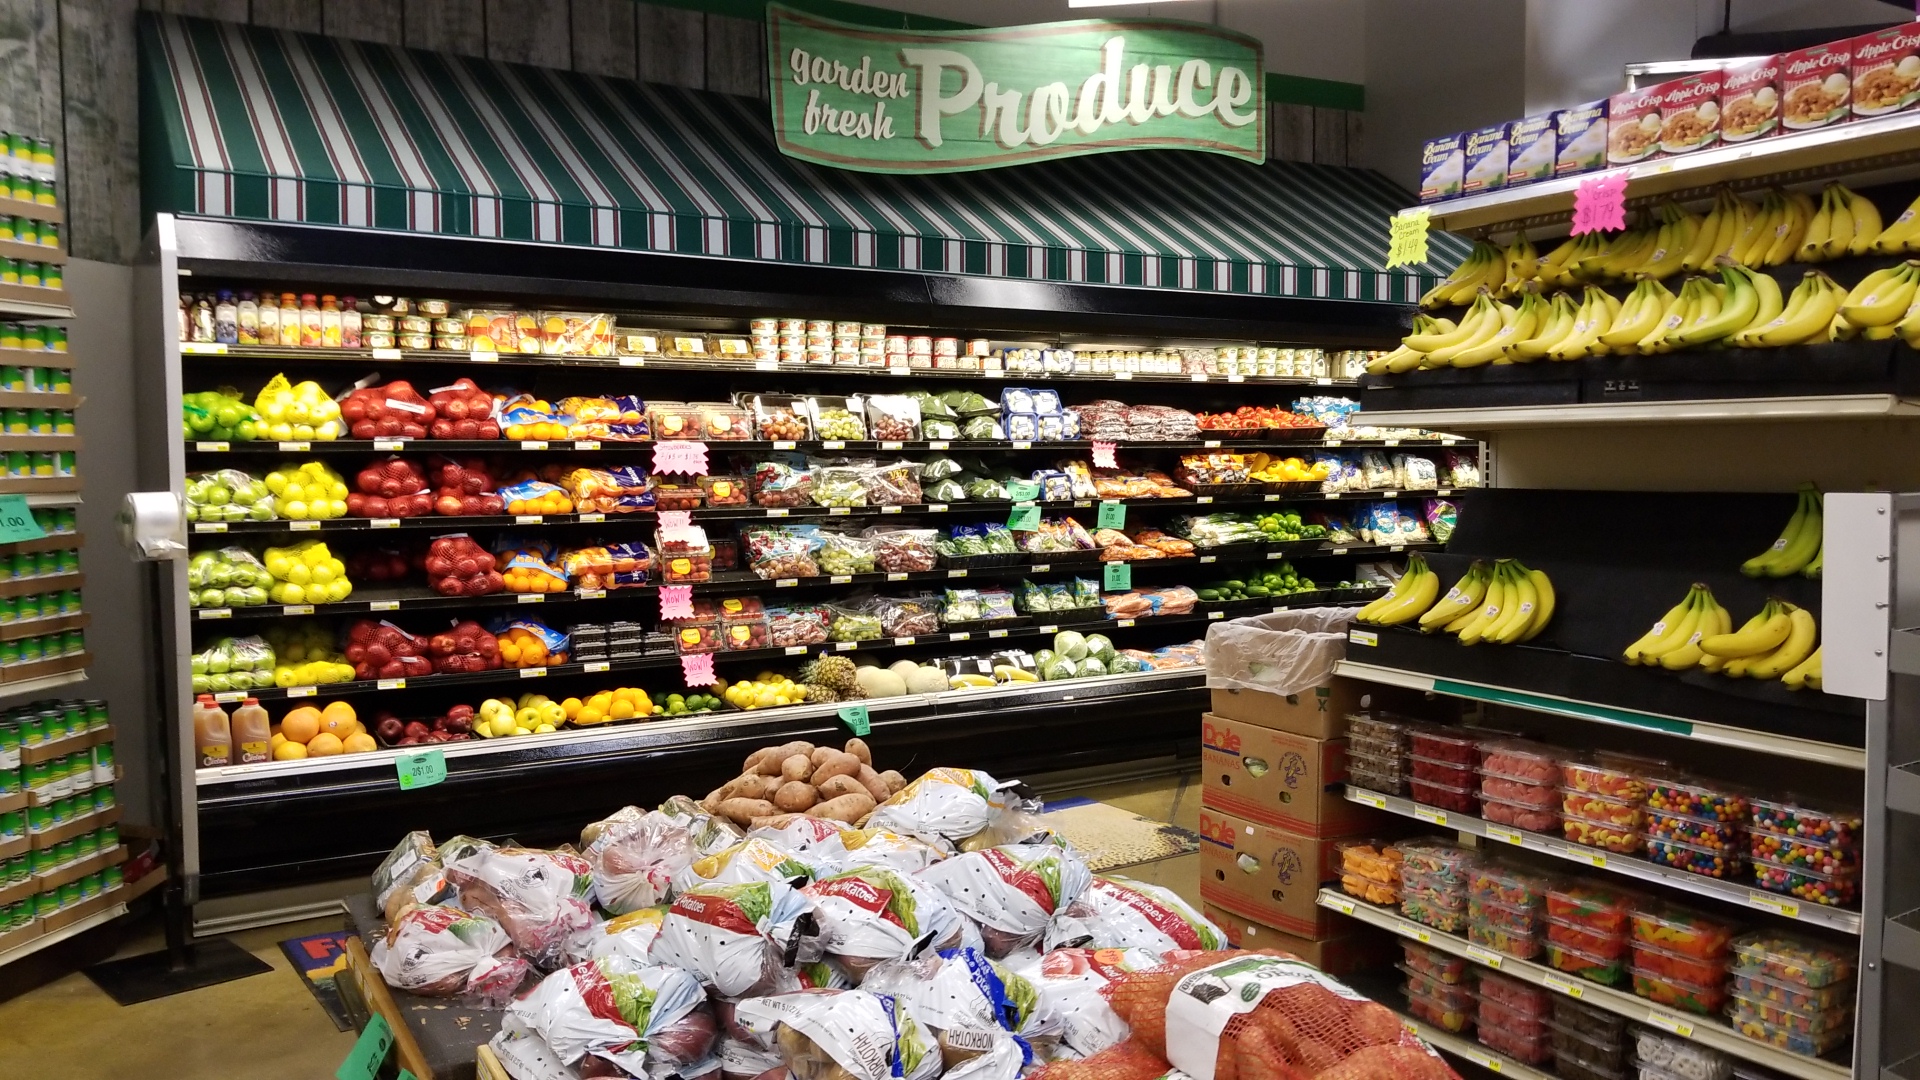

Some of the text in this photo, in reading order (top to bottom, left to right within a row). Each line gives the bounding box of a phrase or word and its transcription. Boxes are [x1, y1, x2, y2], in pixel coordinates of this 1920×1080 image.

[1855, 42, 1892, 59] Apple
[789, 46, 910, 98] garden
[1786, 52, 1851, 74] Apple Crisp
[1723, 67, 1778, 90] Apple Crisp
[901, 36, 1256, 149] Produce
[1665, 82, 1720, 103] Apple Crisp
[1611, 95, 1663, 115] Apple Crisp
[805, 89, 896, 141] fresh
[1559, 107, 1603, 124] Banana
[1510, 119, 1551, 135] Banana
[1558, 121, 1590, 136] Cream
[1467, 130, 1504, 145] Banana
[1510, 132, 1539, 146] Cream
[1424, 140, 1459, 154] Banana
[1466, 144, 1493, 157] Cream
[1423, 153, 1448, 165] Cream
[1394, 219, 1419, 234] Banana
[1203, 723, 1241, 751] Dole
[1203, 752, 1240, 770] BANANAS
[412, 765, 433, 776] 2/$1.00
[1200, 815, 1236, 846] Dole
[680, 896, 706, 914] Potatoes
[949, 1028, 995, 1049] NORKOTAH
[853, 1032, 887, 1080] NORKOTAH
